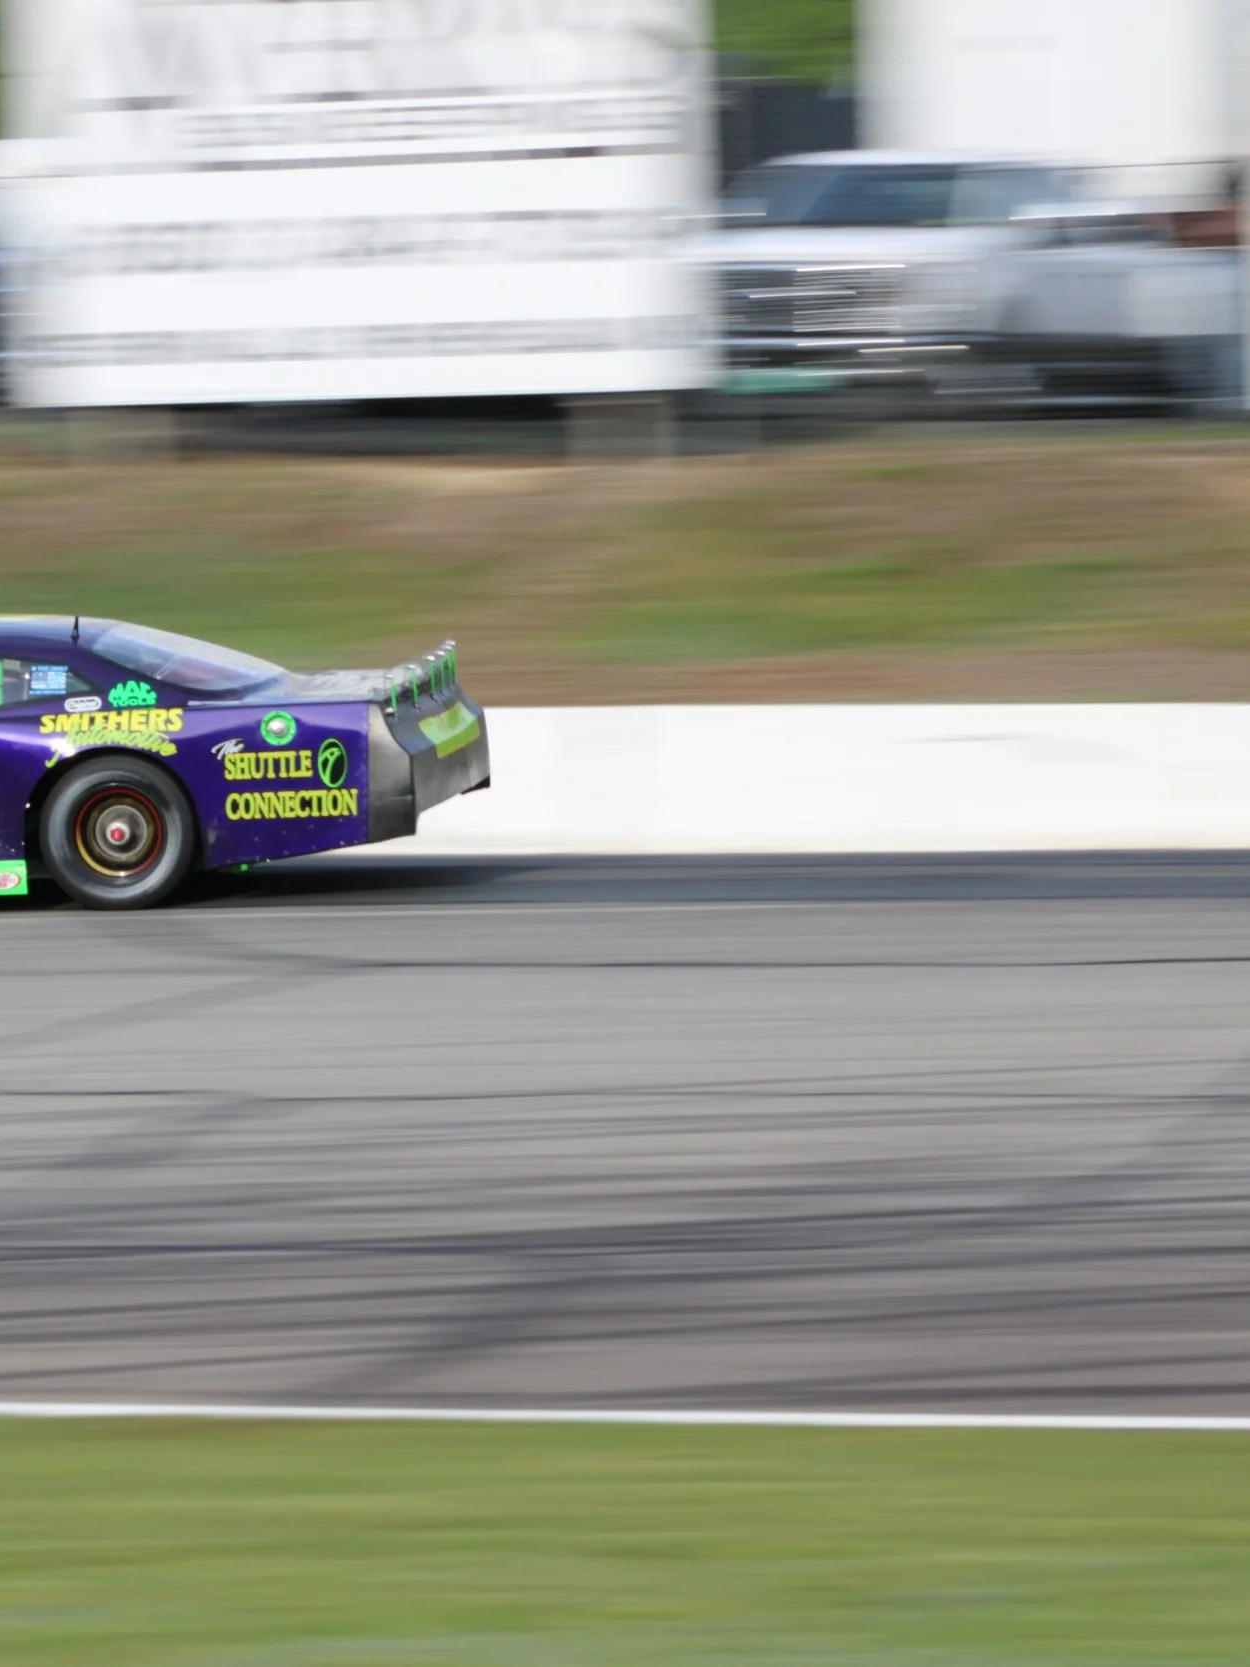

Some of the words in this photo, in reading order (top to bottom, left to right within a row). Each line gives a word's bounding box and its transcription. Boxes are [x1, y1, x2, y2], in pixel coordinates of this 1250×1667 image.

[108, 680, 157, 702] MAC
[39, 708, 184, 734] SMITHERS
[211, 738, 245, 760] The
[224, 750, 313, 780] SHUTTLE
[225, 788, 359, 820] CONNECTION
